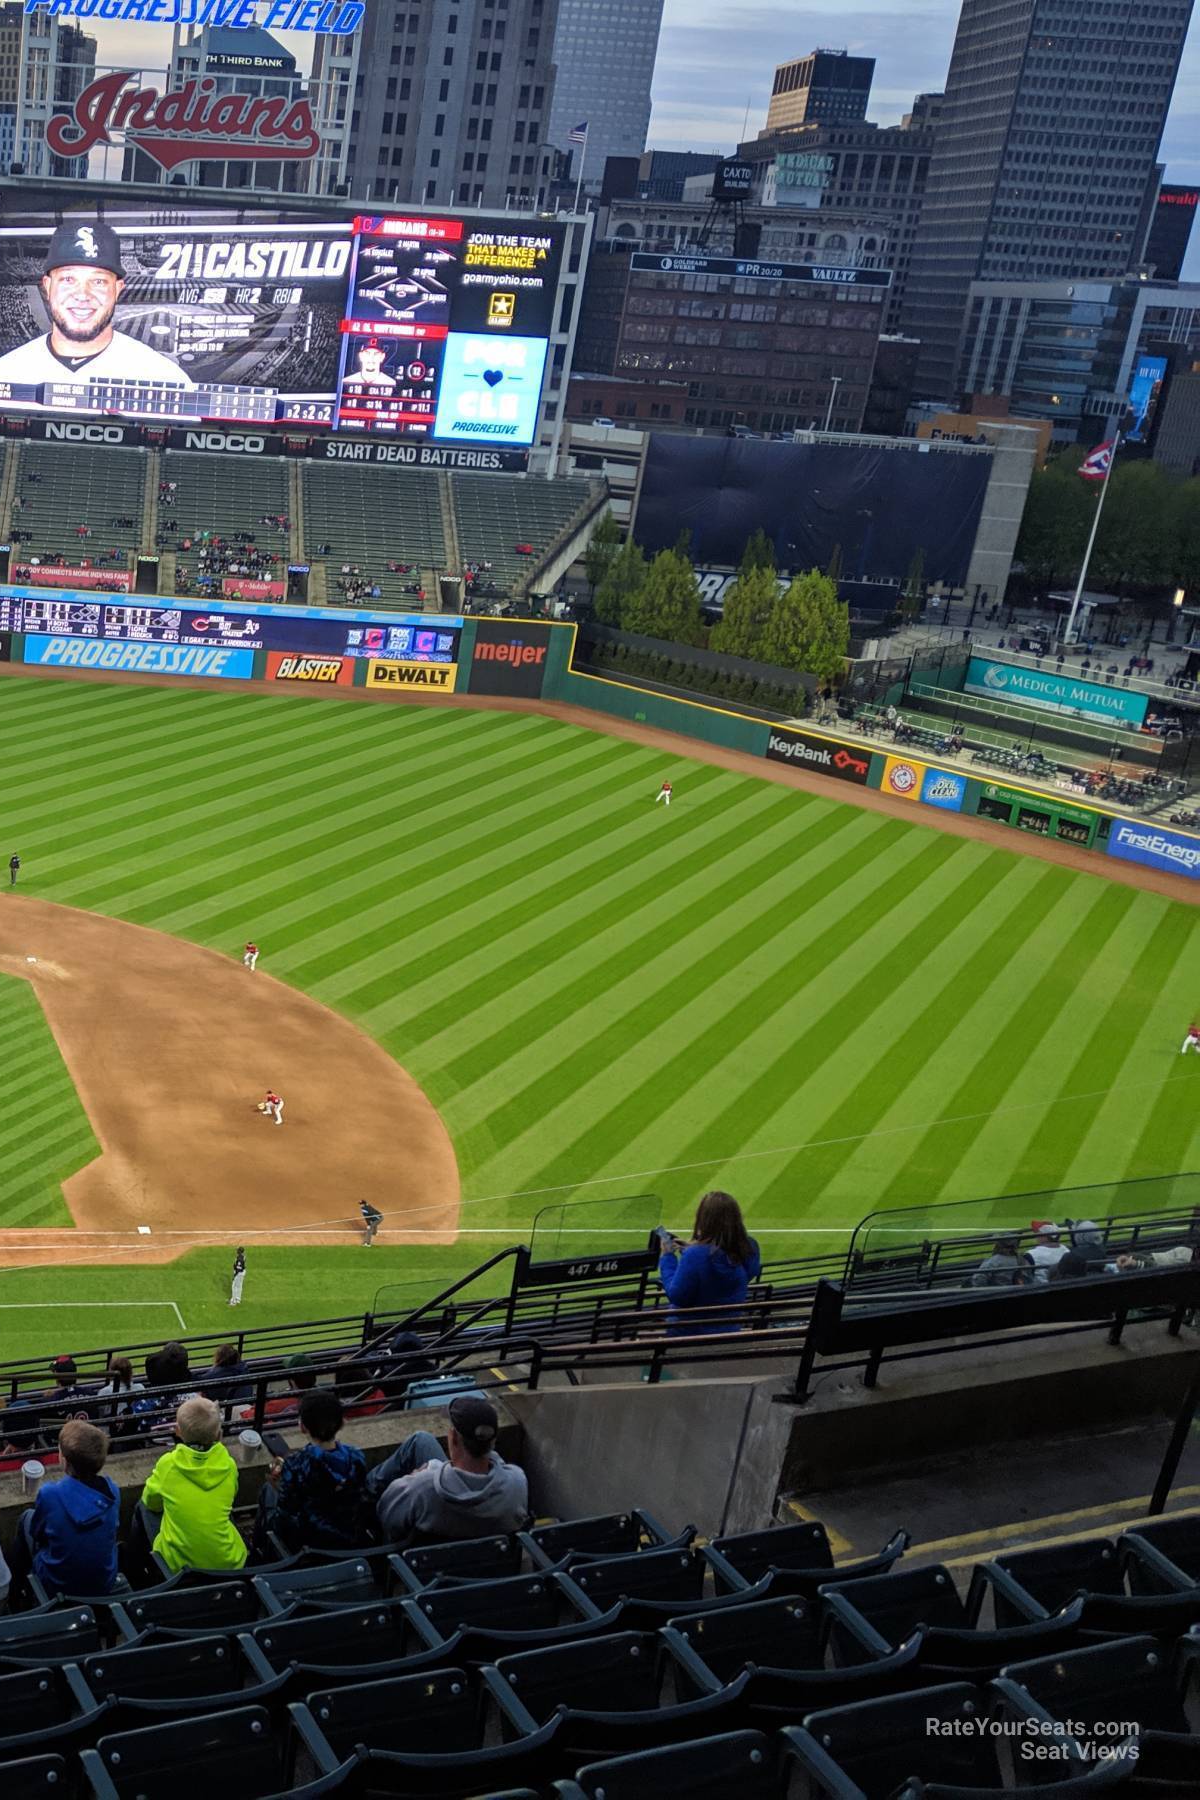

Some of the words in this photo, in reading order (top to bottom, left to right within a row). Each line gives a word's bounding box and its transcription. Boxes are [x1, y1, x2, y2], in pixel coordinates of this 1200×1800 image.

[261, 0, 365, 35] FIELD
[47, 71, 320, 160] Indians
[467, 233, 494, 244] JOIN
[496, 235, 518, 246] THE
[520, 237, 551, 248] TEAM
[467, 243, 496, 254] THAT
[497, 246, 536, 258] MAKES
[537, 248, 547, 259] A
[155, 244, 194, 279] 21
[203, 241, 352, 278] CASTILLO
[464, 254, 537, 268] DIFFERENCE.
[746, 264, 760, 275] PR
[760, 269, 783, 277] 20/20
[812, 268, 857, 282] VAULTZ
[462, 273, 543, 287] goarmyohio.com
[178, 288, 199, 304] AVG
[234, 288, 250, 304] HR
[250, 287, 261, 304] 2
[273, 288, 290, 304] RBI
[293, 404, 301, 418] 2
[308, 405, 316, 419] 2
[323, 406, 331, 420] 2
[45, 422, 124, 444] NOCO
[451, 421, 519, 435] PROGRESSIVE
[186, 432, 265, 453] NOCO
[326, 441, 371, 460] START
[376, 446, 417, 464] DEAD
[420, 450, 503, 469] BATTERIES.
[41, 567, 72, 575] CONNECTS
[288, 565, 310, 573] NOCO
[391, 628, 409, 637] FOX
[41, 638, 232, 675] PROGRESSIVE
[474, 639, 545, 667] meijer
[277, 658, 341, 681] BLASTER
[1010, 674, 1067, 698] MEDICAL
[1070, 687, 1125, 711] MUTUAL
[768, 735, 832, 766] KeyBank
[1116, 827, 1200, 866] FirstEnergy
[568, 1263, 590, 1276] 447
[595, 1260, 618, 1273] 446
